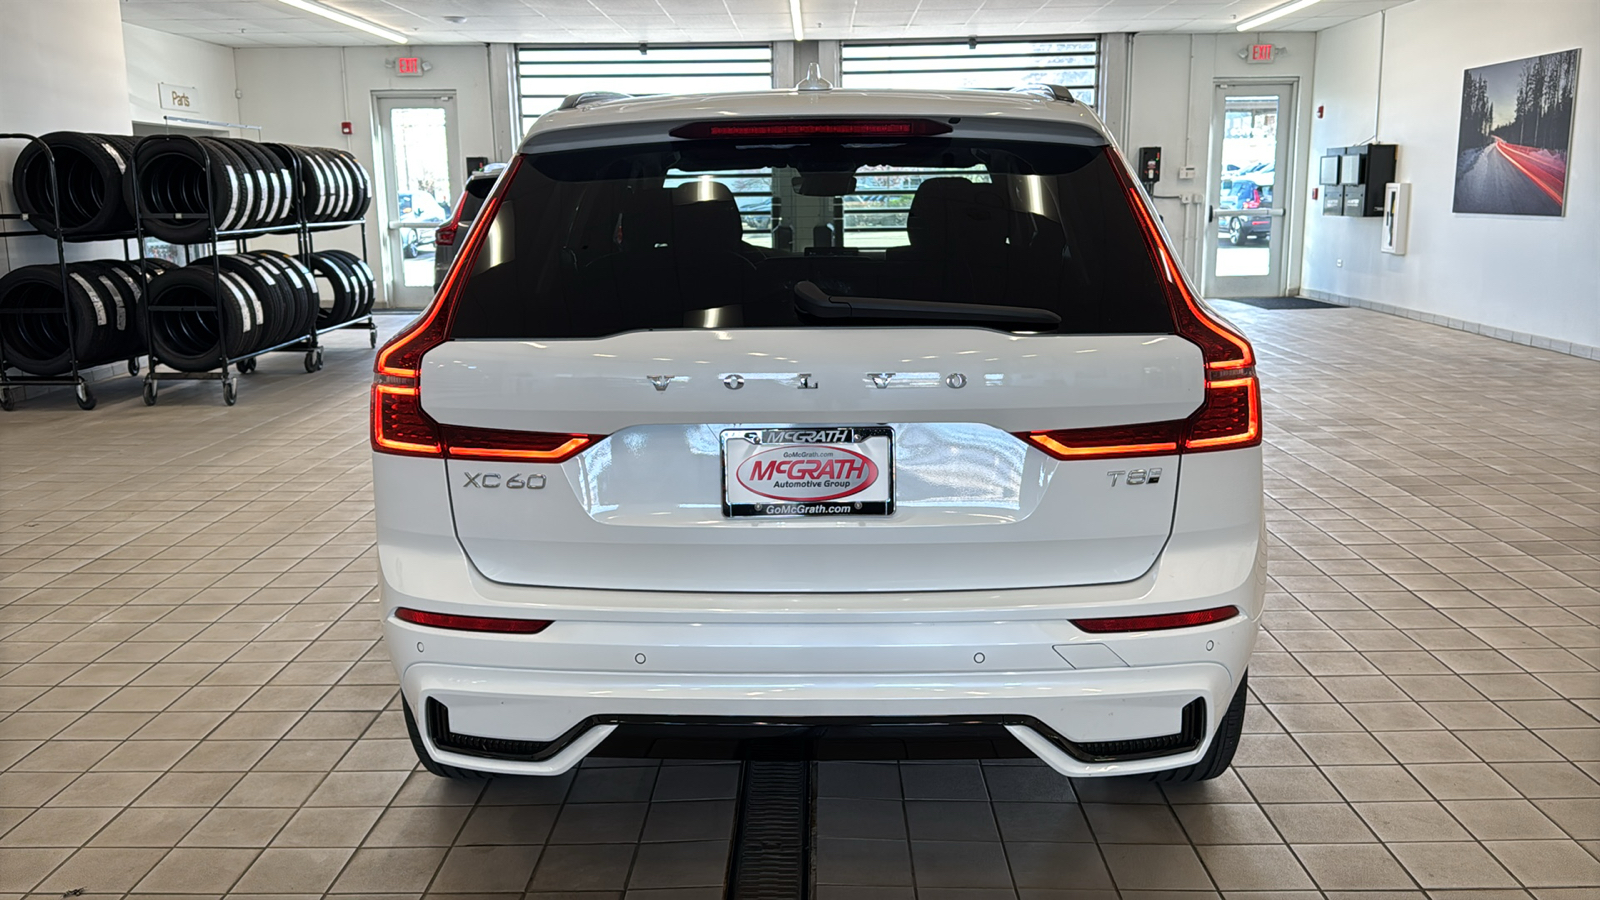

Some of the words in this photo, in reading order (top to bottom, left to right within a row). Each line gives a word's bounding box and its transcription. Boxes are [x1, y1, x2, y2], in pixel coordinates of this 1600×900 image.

[1252, 44, 1272, 60] EXIT
[399, 57, 418, 73] EXIT
[646, 373, 968, 391] VOLVO
[773, 480, 822, 489] Automotive
[823, 480, 851, 489] Group
[1107, 469, 1147, 488] T8
[766, 504, 851, 515] GoMcGrath.com
